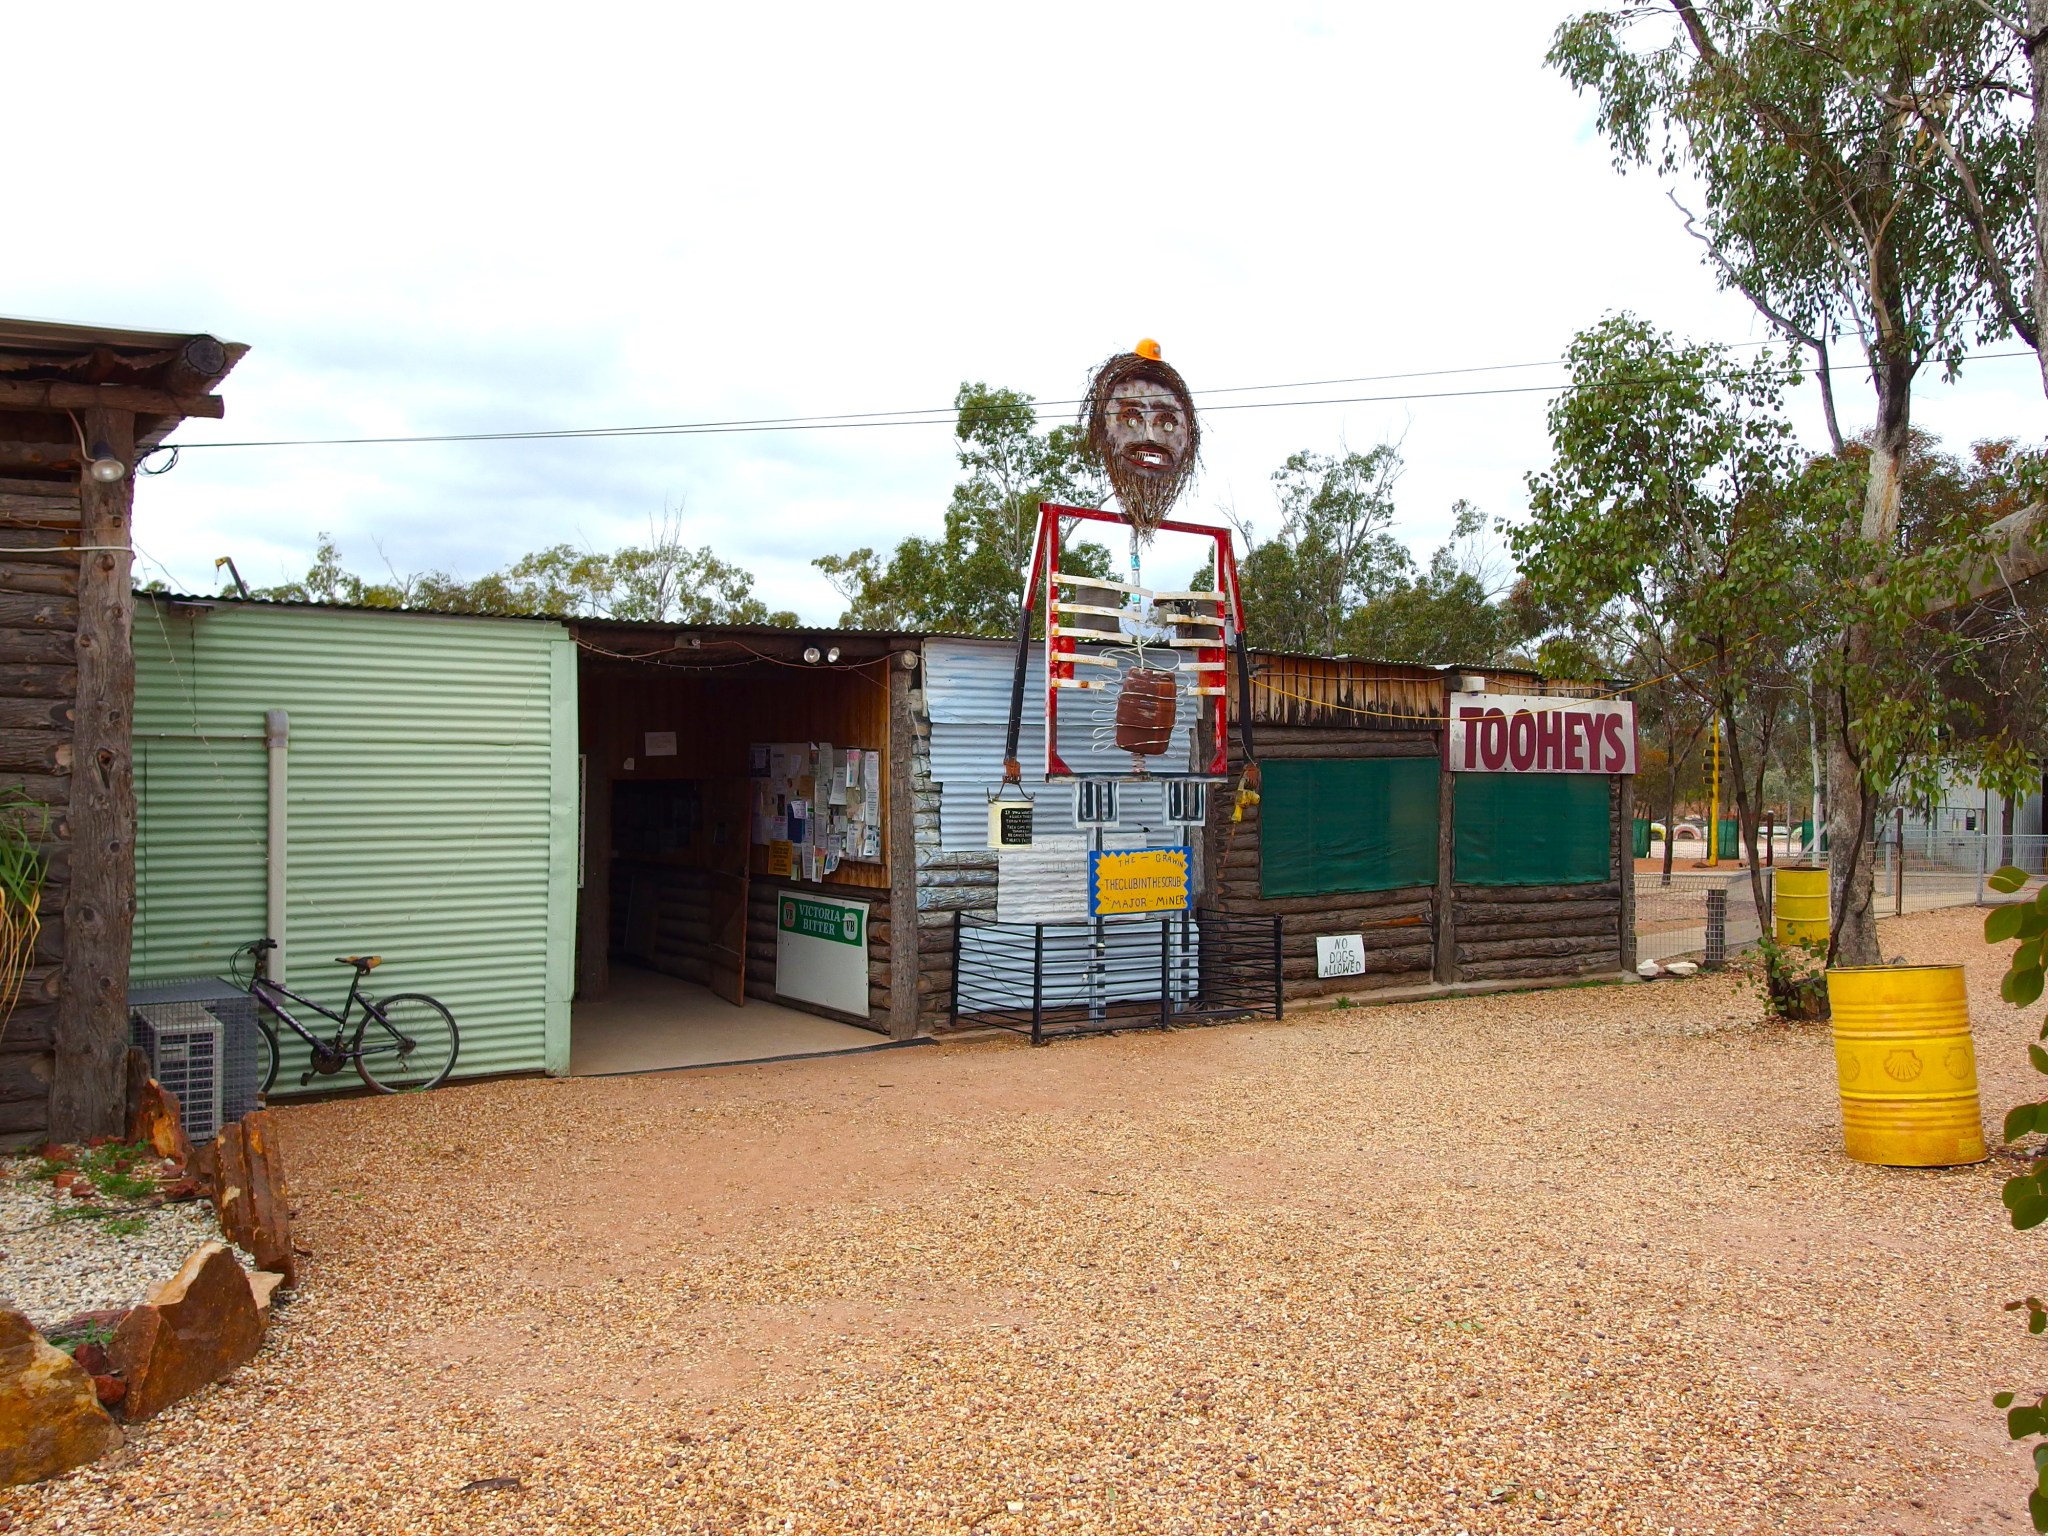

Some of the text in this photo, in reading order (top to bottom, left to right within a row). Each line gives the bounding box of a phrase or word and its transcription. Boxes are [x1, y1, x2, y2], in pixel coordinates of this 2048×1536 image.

[1460, 707, 1626, 772] TOOHEYS
[1118, 857, 1136, 867] THE
[1155, 853, 1184, 868] GRAWIN
[1111, 898, 1147, 909] MAJOR
[785, 908, 794, 920] VB
[799, 904, 841, 923] VICTORIA
[802, 918, 835, 936] BITTER
[846, 920, 855, 933] VB
[1334, 938, 1348, 950] NO
[1329, 950, 1355, 964] DOGS
[1323, 961, 1361, 976] ALLOWED
